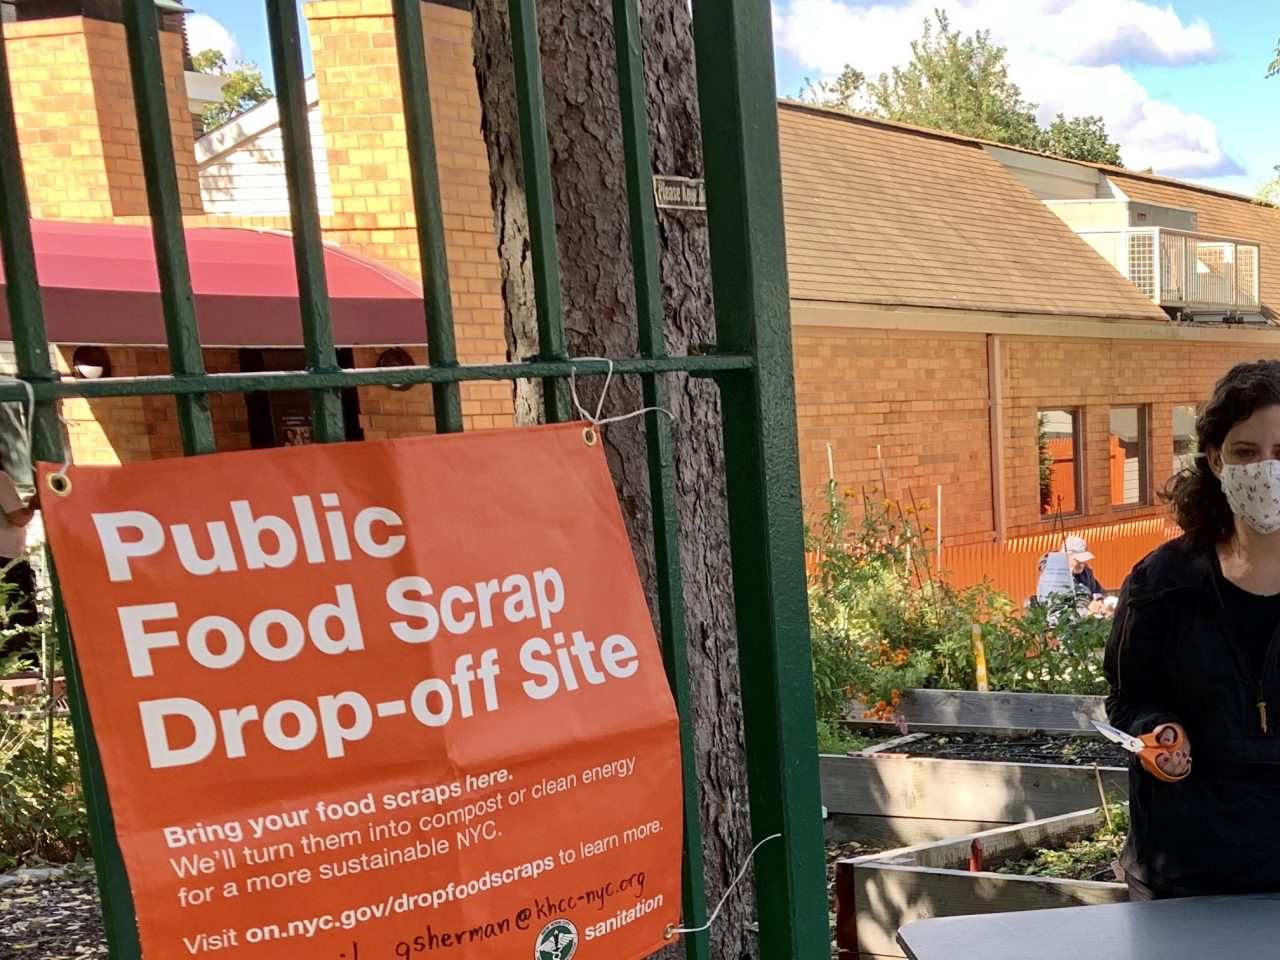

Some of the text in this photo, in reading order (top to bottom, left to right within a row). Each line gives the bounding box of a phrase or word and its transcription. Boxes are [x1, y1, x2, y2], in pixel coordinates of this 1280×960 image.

[658, 180, 681, 201] Please
[92, 492, 407, 582] Public
[117, 566, 566, 678] Food Scrap
[138, 631, 640, 769] Drop-off Site
[163, 767, 513, 849] Bring your food scraps here.
[169, 756, 637, 879] We'll turn them into compost or clean energy
[177, 820, 502, 907] for a more sustainable NYC.
[182, 819, 664, 955] Visit on.nyc.gov/dropfoodscraps to learn more.
[584, 893, 664, 941] sanitation
